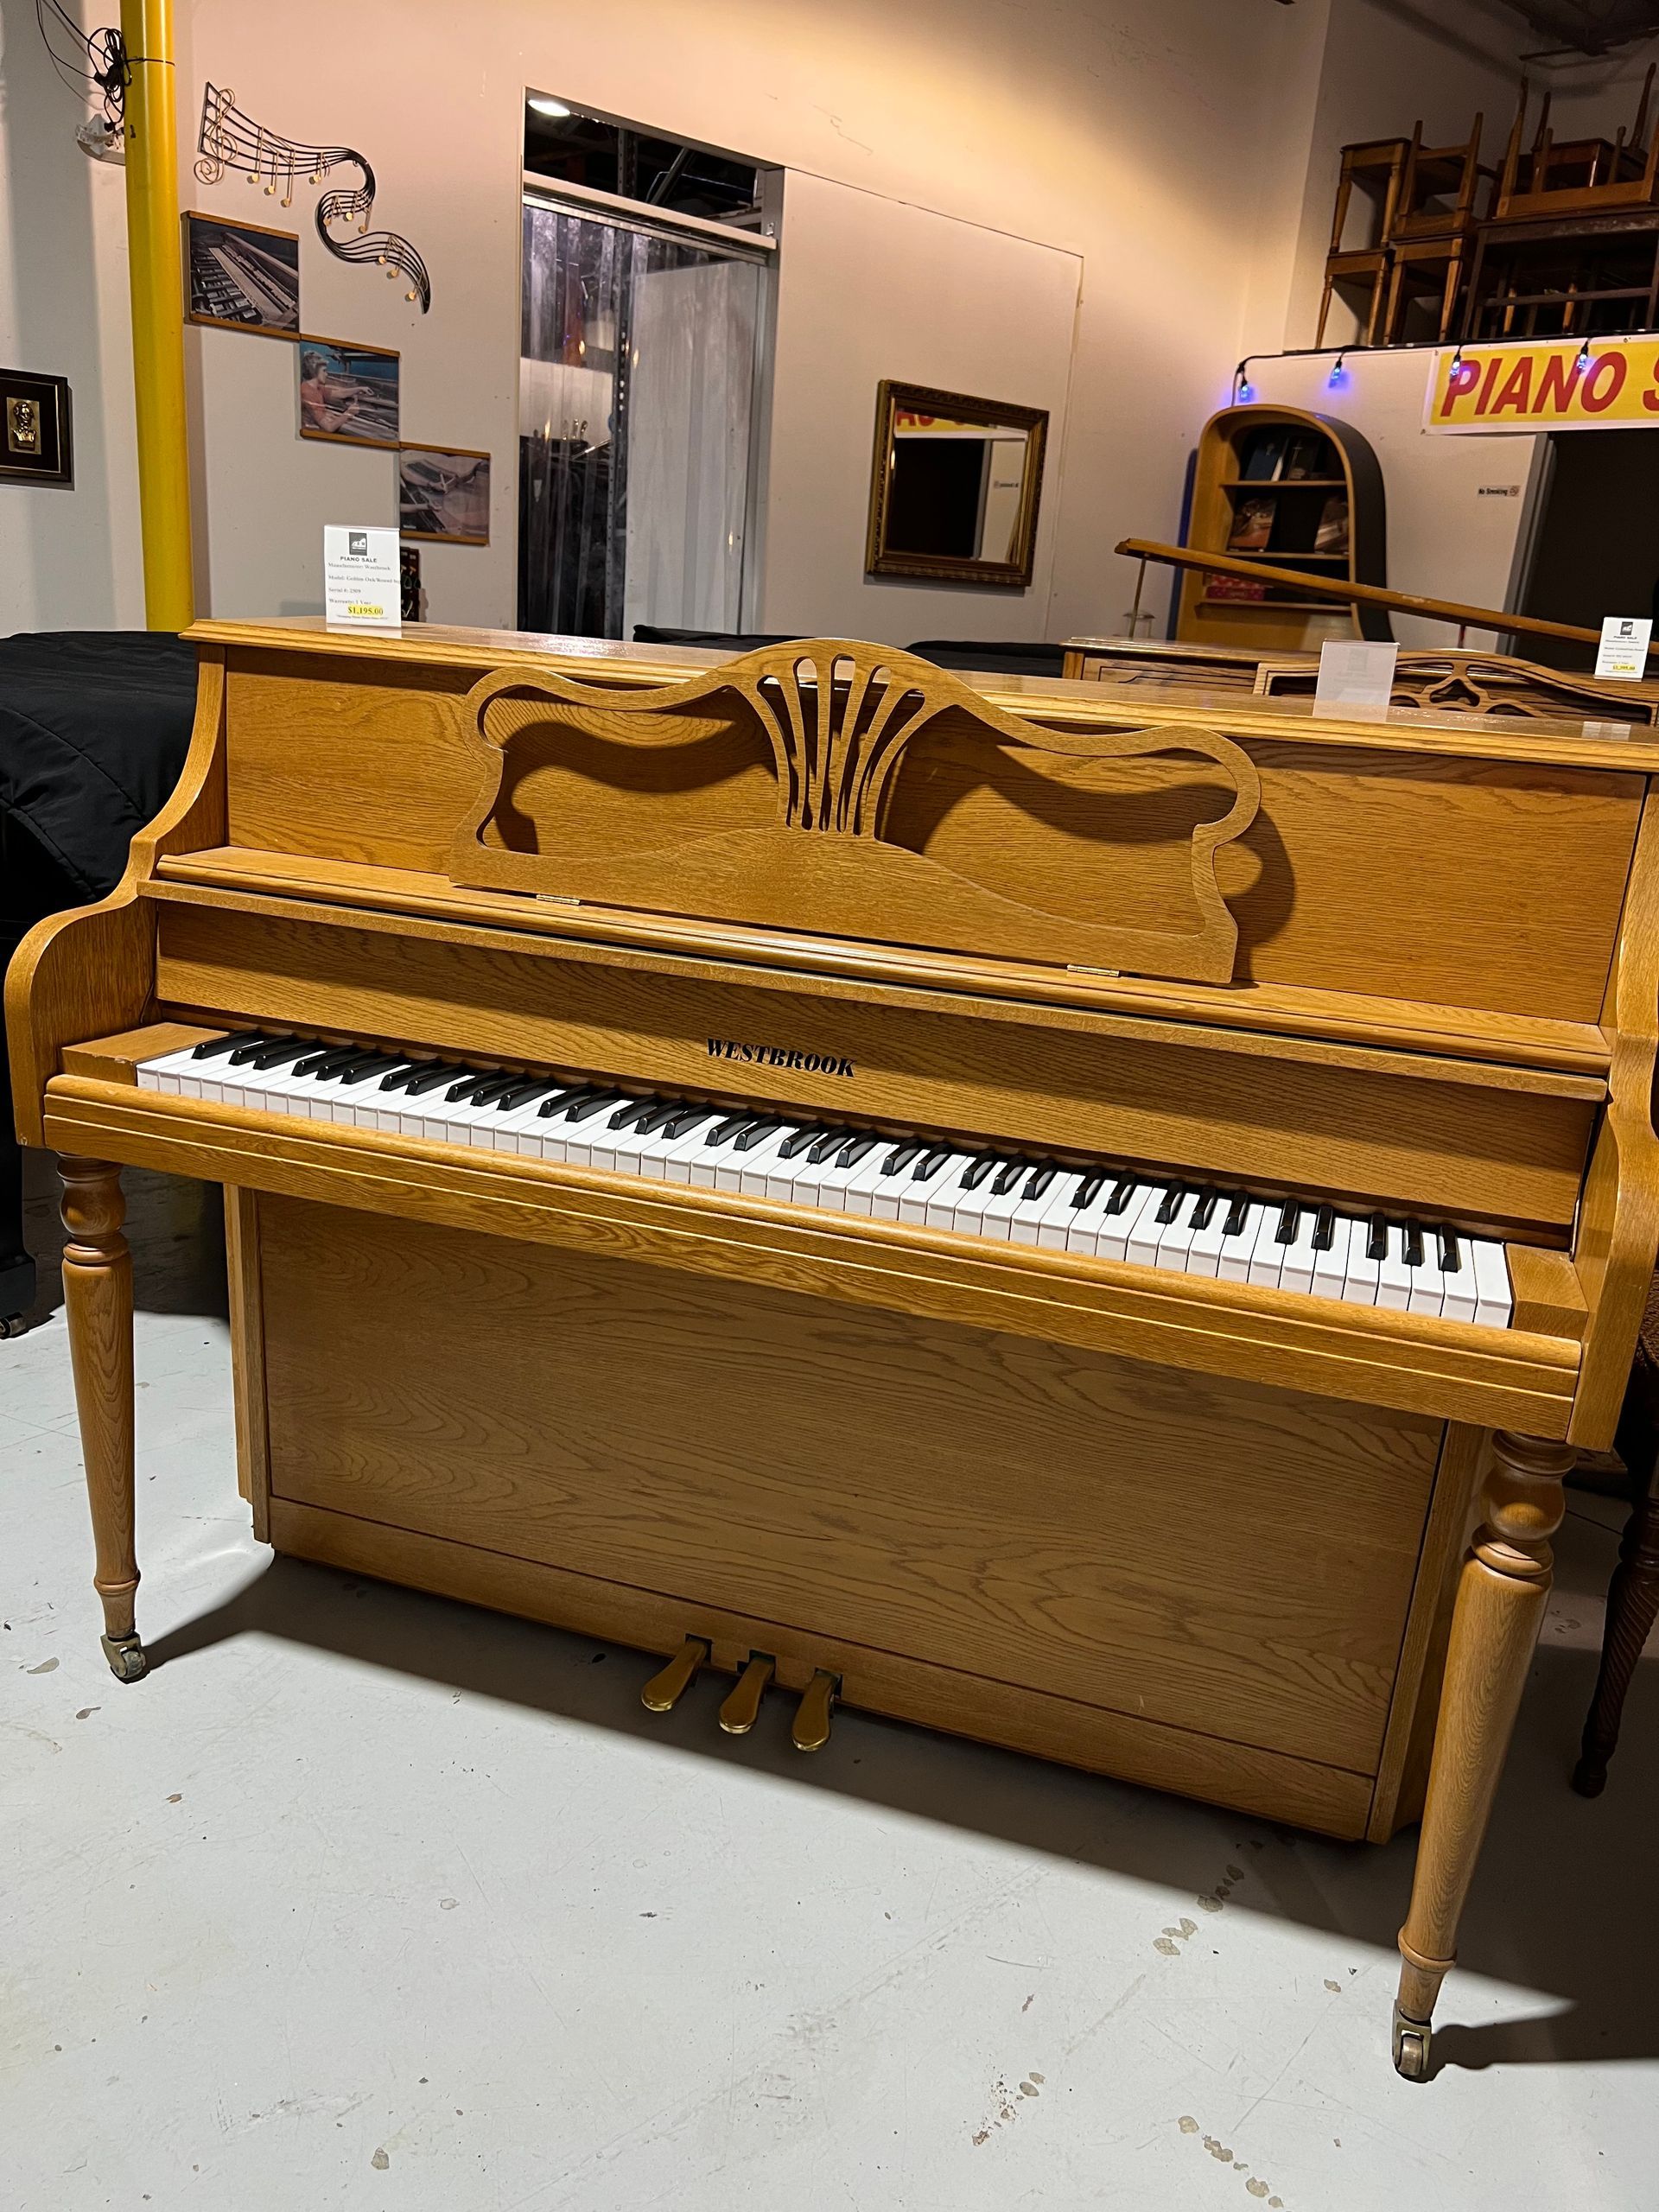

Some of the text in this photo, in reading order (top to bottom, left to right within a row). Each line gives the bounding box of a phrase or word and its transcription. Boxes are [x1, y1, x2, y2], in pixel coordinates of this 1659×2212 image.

[1440, 351, 1627, 417] PIANO
[347, 606, 384, 615] $1,195.00
[707, 1037, 857, 1078] WESTBROOK
